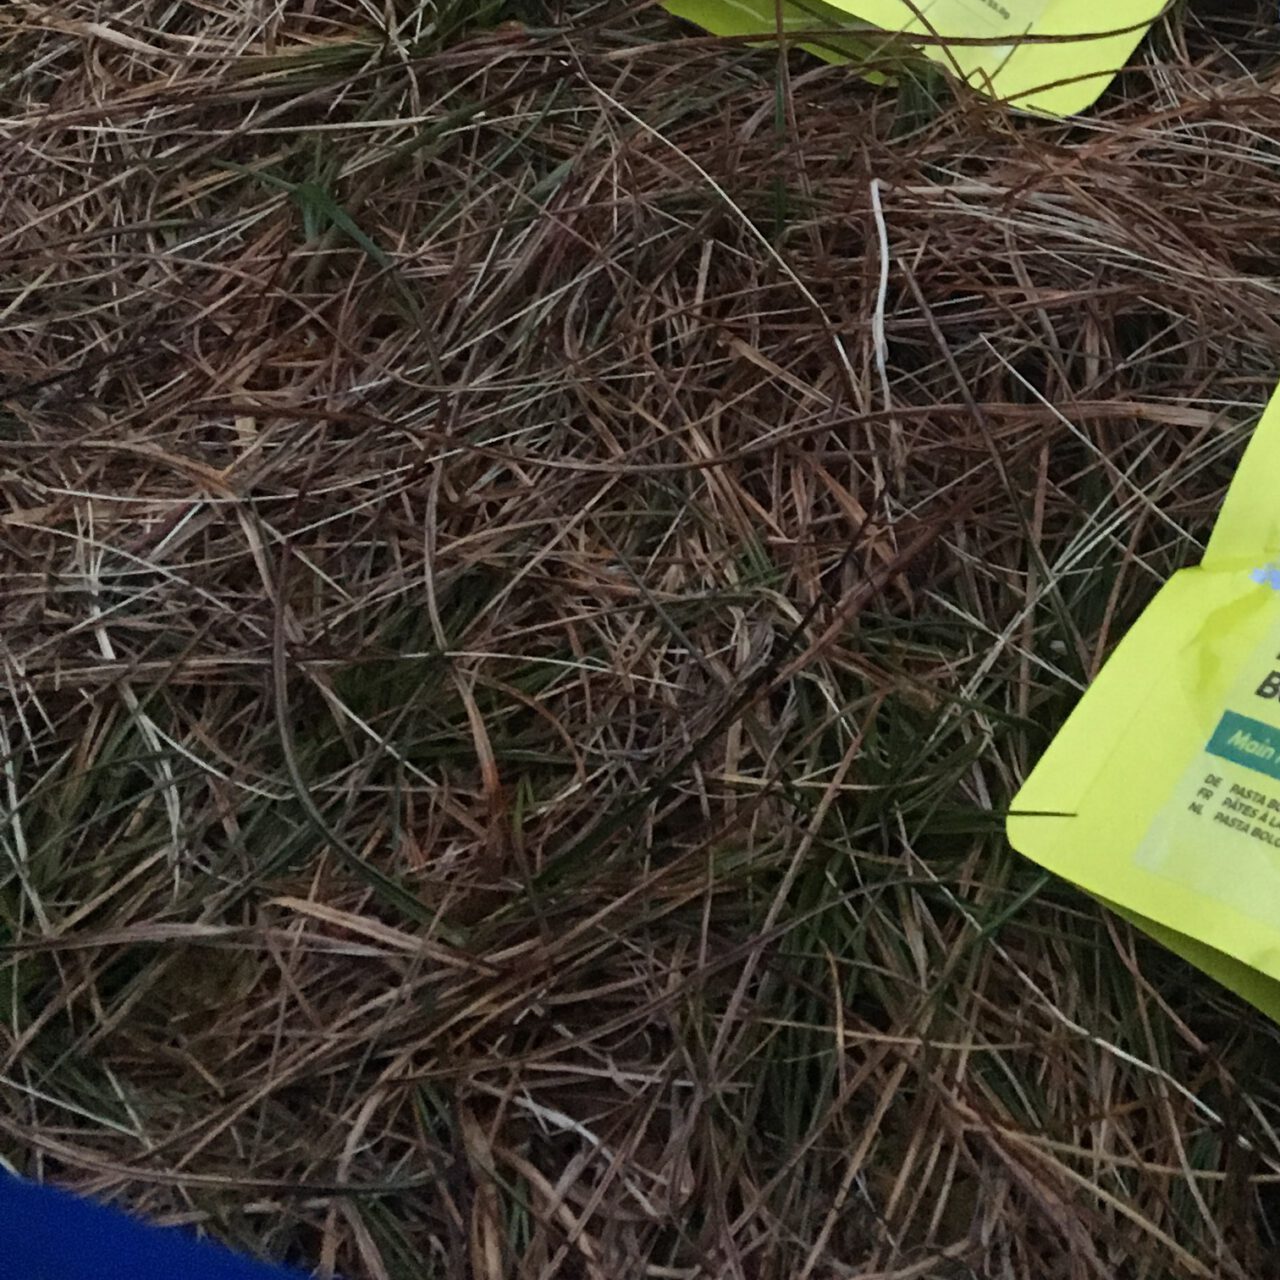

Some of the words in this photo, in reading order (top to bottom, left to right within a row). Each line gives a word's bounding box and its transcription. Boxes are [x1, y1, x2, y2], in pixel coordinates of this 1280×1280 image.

[1227, 730, 1276, 760] Main
[1197, 787, 1214, 800] FR
[1204, 774, 1223, 787] DE
[1229, 784, 1267, 805] PASTA
[1214, 811, 1250, 833] PASTA
